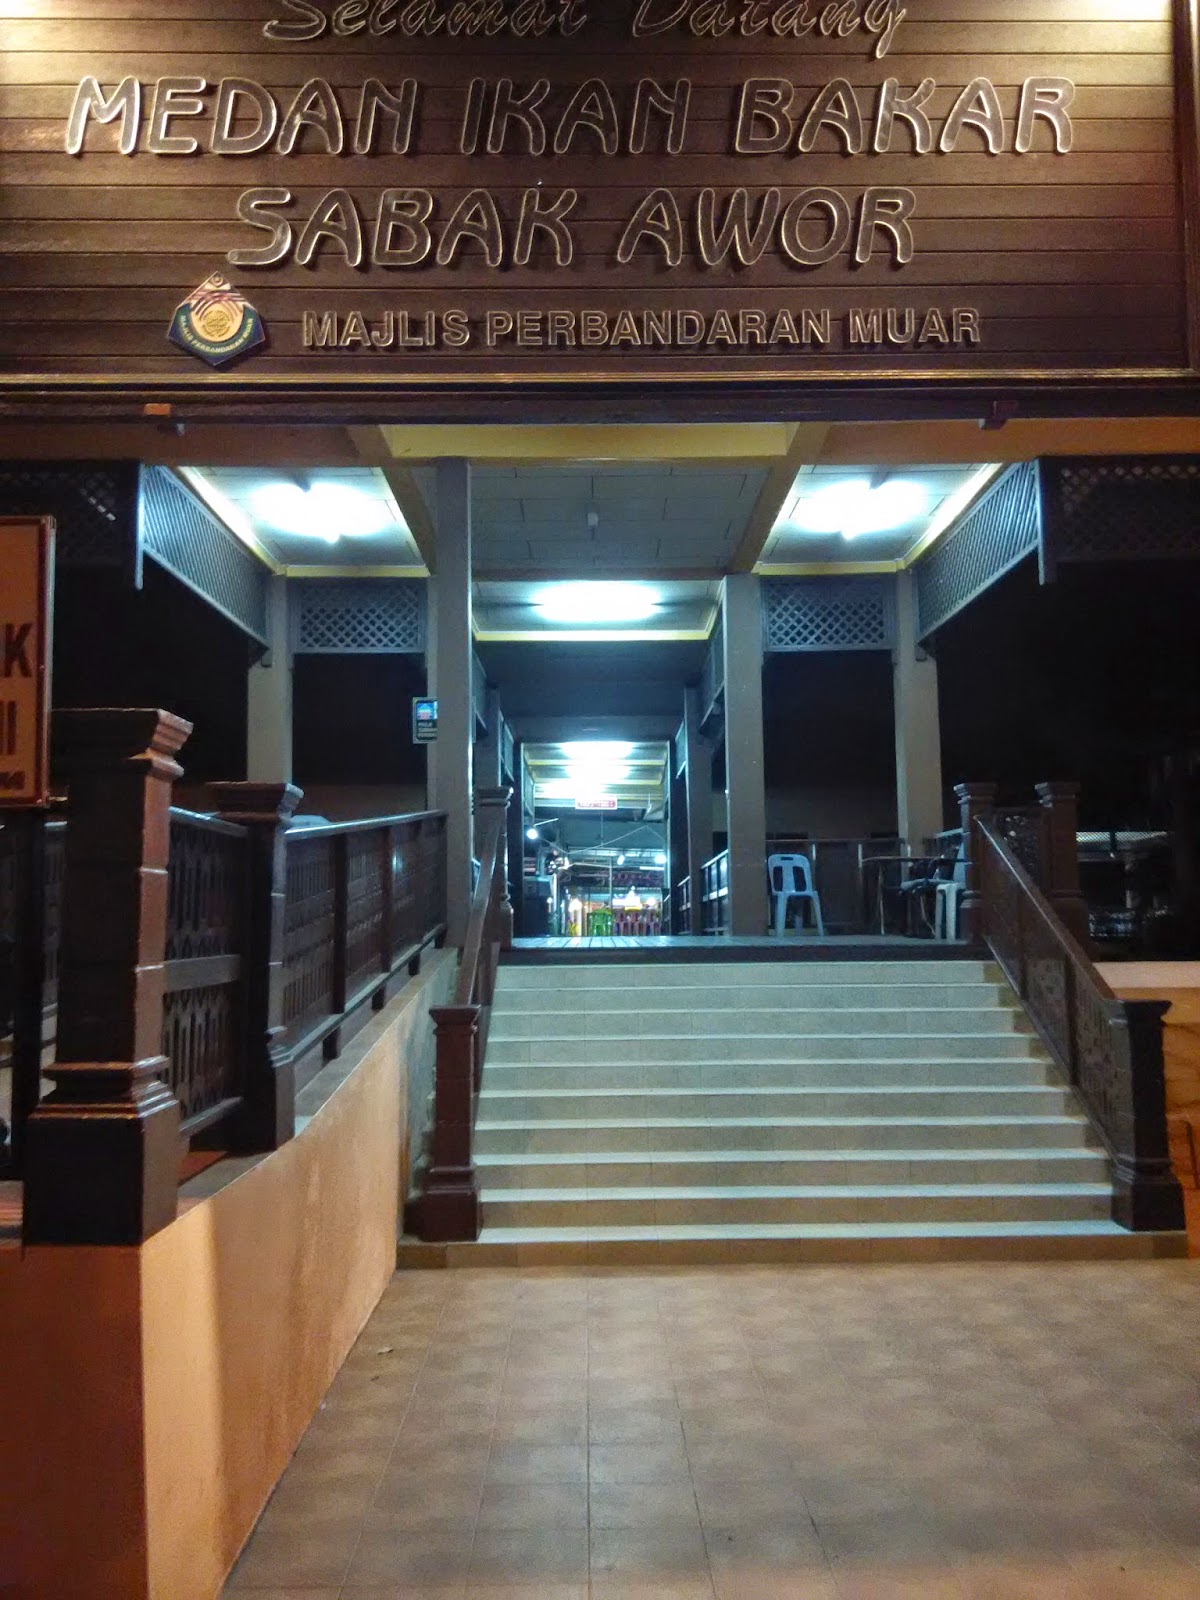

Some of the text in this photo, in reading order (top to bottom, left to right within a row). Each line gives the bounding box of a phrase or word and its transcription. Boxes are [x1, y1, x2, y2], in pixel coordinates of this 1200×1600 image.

[66, 75, 1076, 155] MEDAN IKAN BAKAR
[226, 186, 917, 267] SABAK AWOR
[302, 307, 981, 347] MAJLIS PERBANDARAN MUAR
